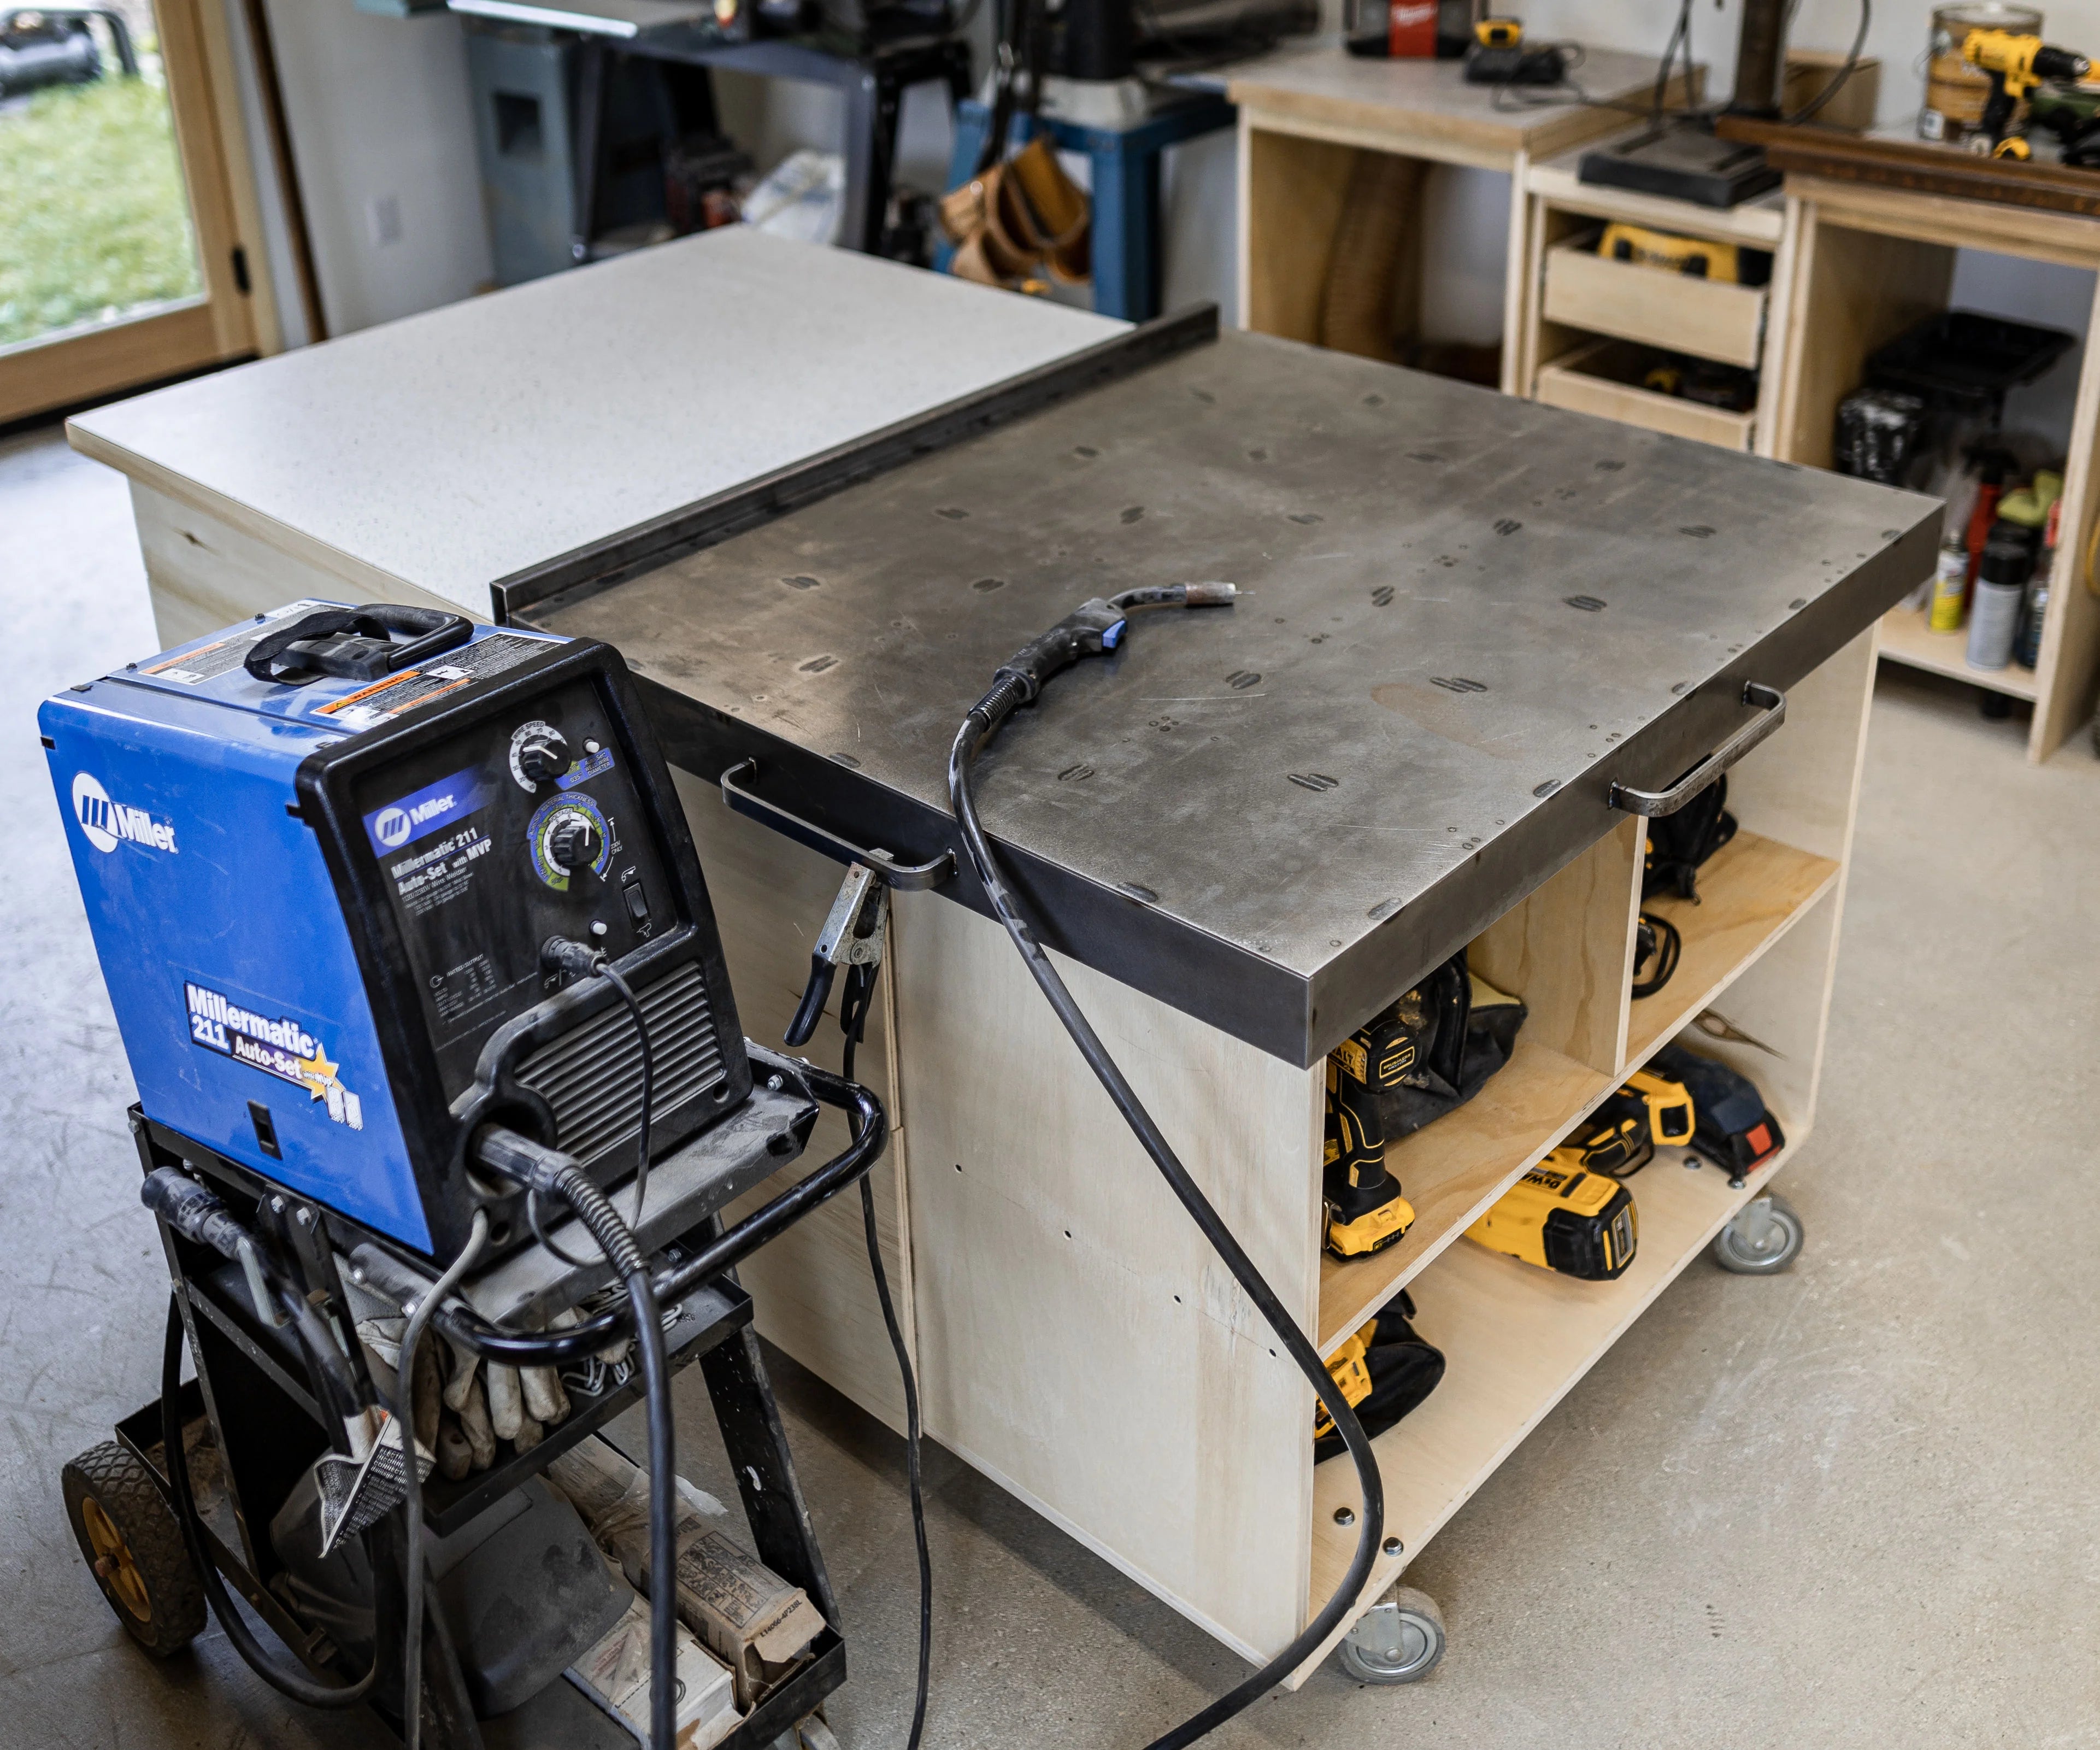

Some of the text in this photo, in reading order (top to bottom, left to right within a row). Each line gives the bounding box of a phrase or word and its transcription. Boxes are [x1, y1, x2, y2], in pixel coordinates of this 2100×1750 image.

[351, 678, 404, 698] WARNING
[526, 721, 544, 729] SPEED
[587, 762, 610, 776] DIAMETER
[409, 794, 454, 825] Miller
[566, 794, 594, 806] THICKNESS
[114, 803, 175, 853] Miller
[548, 809, 573, 823] VOLTAGE
[390, 827, 478, 879] Millermatic 211
[397, 861, 448, 896] Auto-Set
[451, 856, 468, 868] with
[466, 838, 492, 861] MVP
[187, 984, 315, 1059] Millermatic
[192, 1014, 230, 1050] 211
[235, 1035, 303, 1080] Auto-Set
